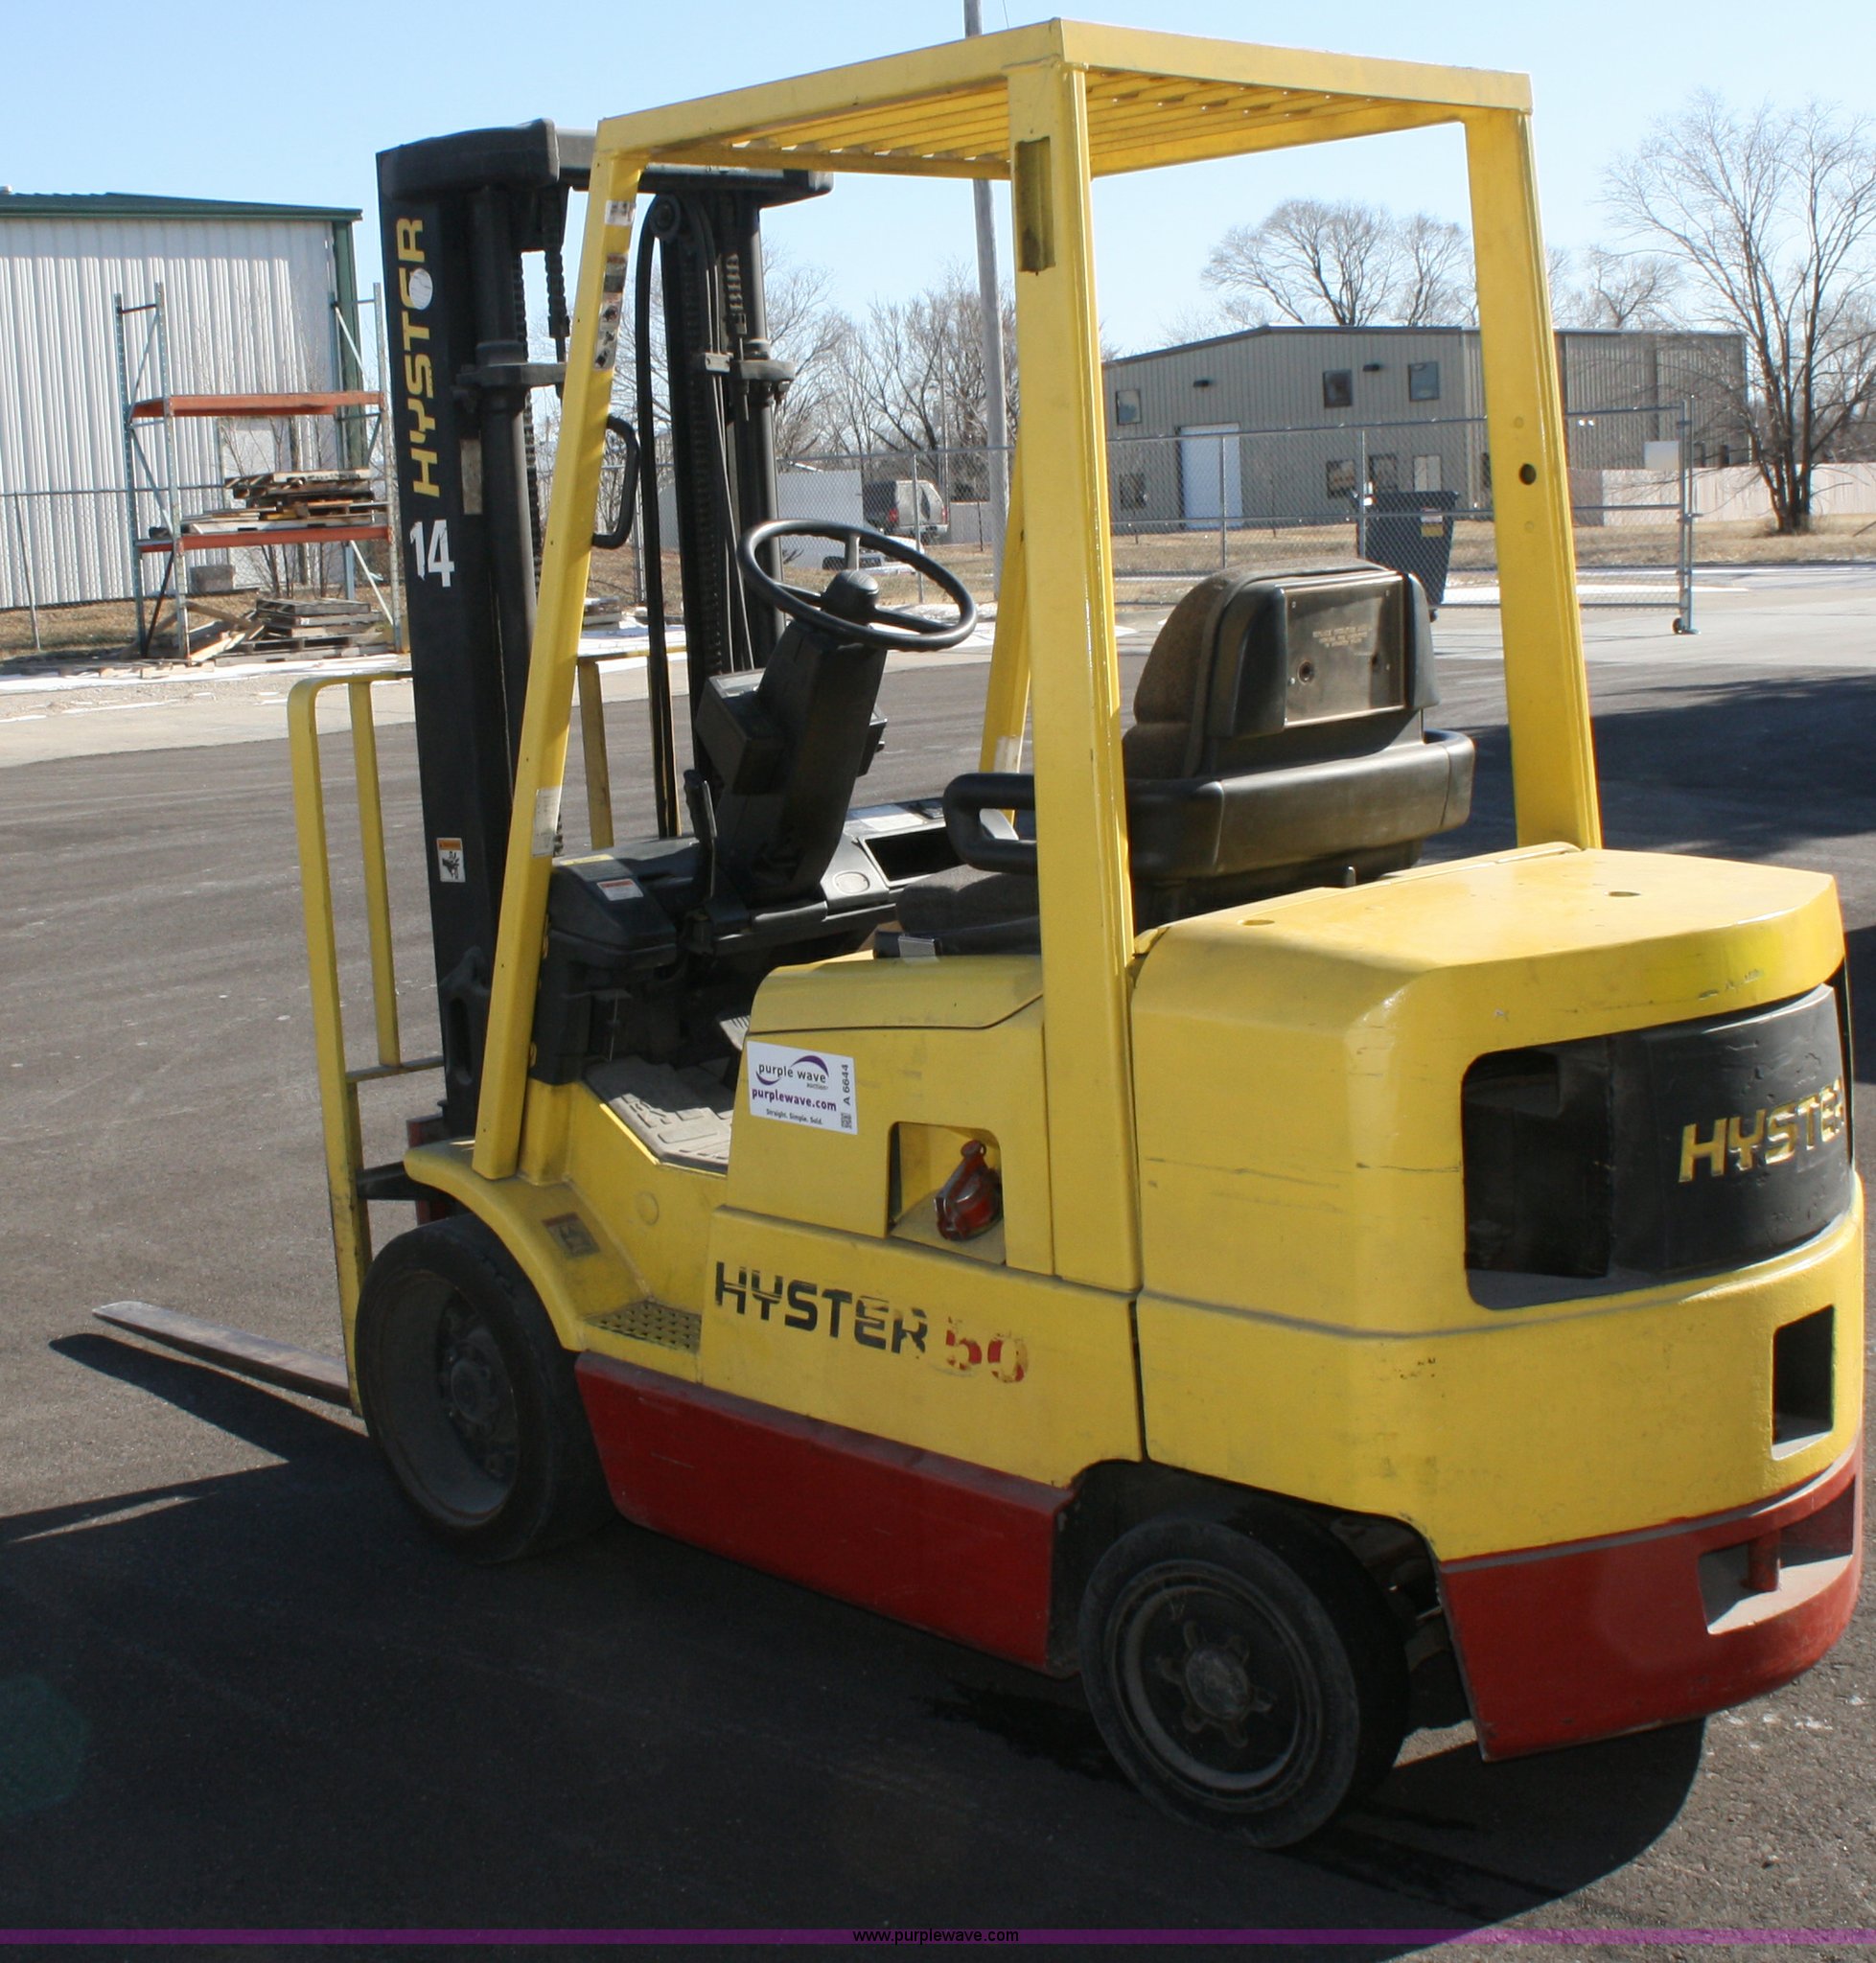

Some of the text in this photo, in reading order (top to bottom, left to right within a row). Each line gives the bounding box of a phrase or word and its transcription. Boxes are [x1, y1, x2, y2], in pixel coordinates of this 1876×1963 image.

[409, 519, 455, 588] 14
[758, 1063, 826, 1083] purple wave
[841, 1064, 851, 1106] A 6644
[752, 1088, 837, 1112] purplewave.com
[714, 1261, 928, 1354] HYSTER
